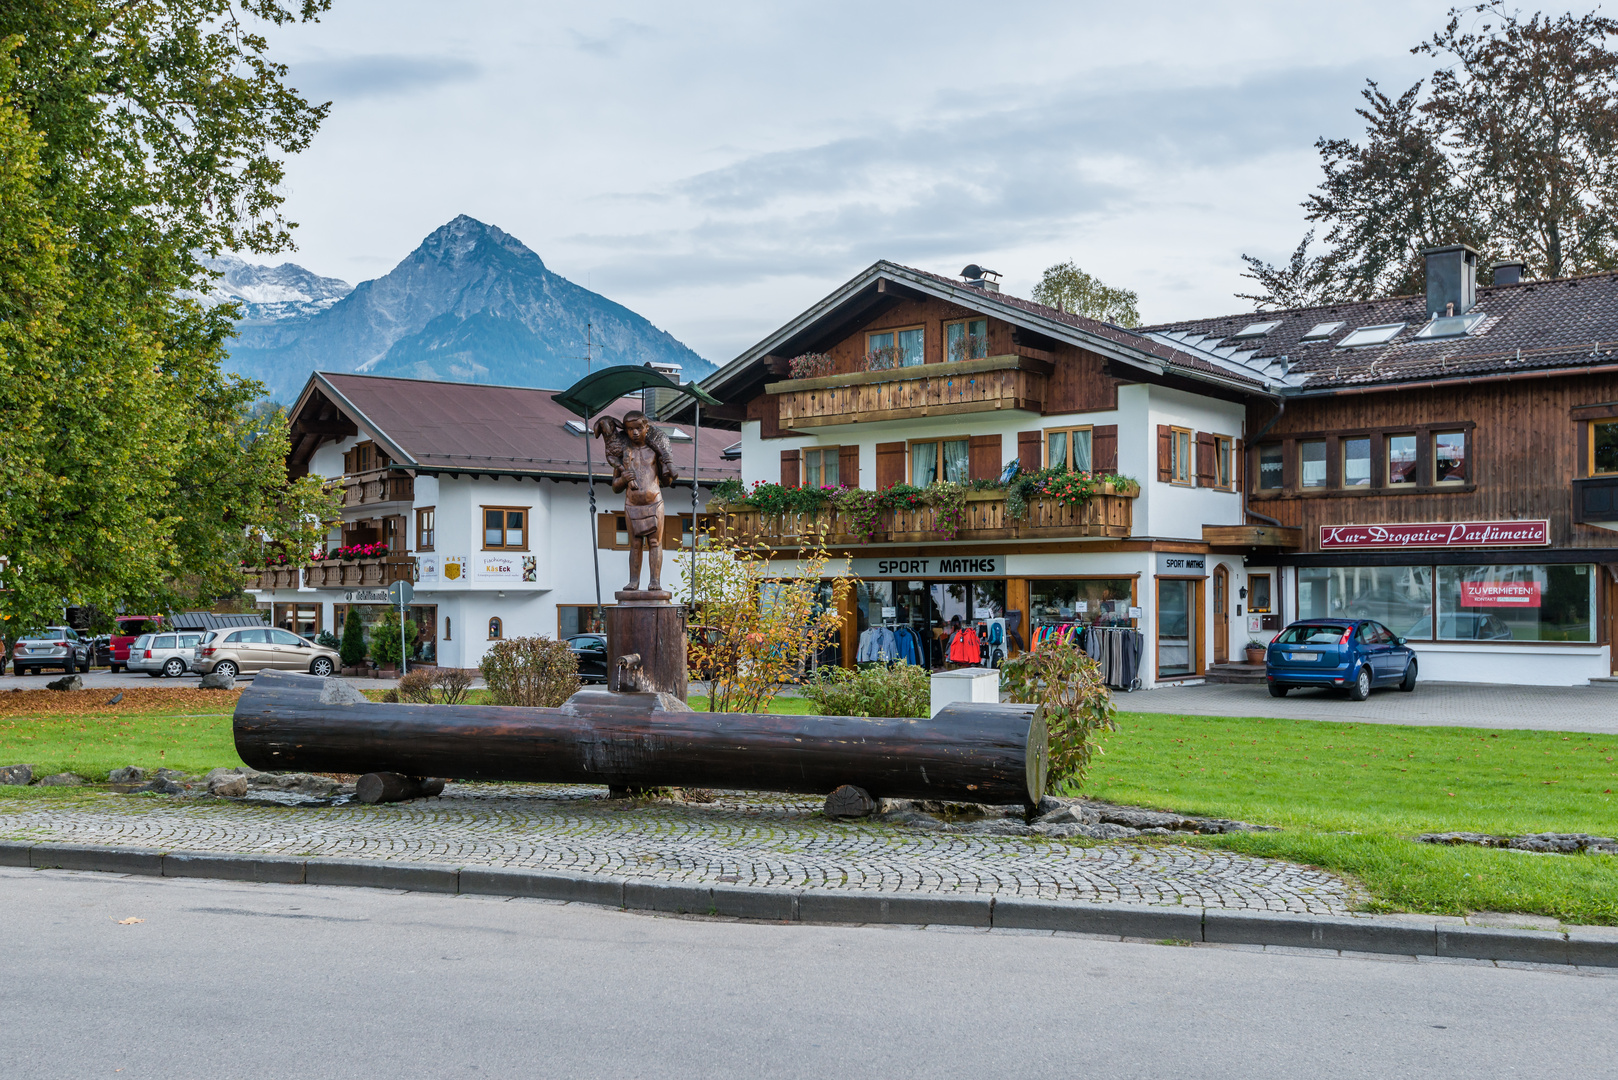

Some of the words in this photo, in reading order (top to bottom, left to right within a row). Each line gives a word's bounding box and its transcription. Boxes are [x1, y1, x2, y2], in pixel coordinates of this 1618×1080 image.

[1322, 523, 1543, 545] Kur-Drogerie-Parfümerie
[878, 560, 929, 573] SPORT
[939, 558, 995, 573] MATHES
[1166, 559, 1185, 568] SPORT
[1185, 559, 1204, 569] MATHES
[1468, 587, 1481, 595] ZU
[1482, 587, 1533, 595] VERMIETEN!
